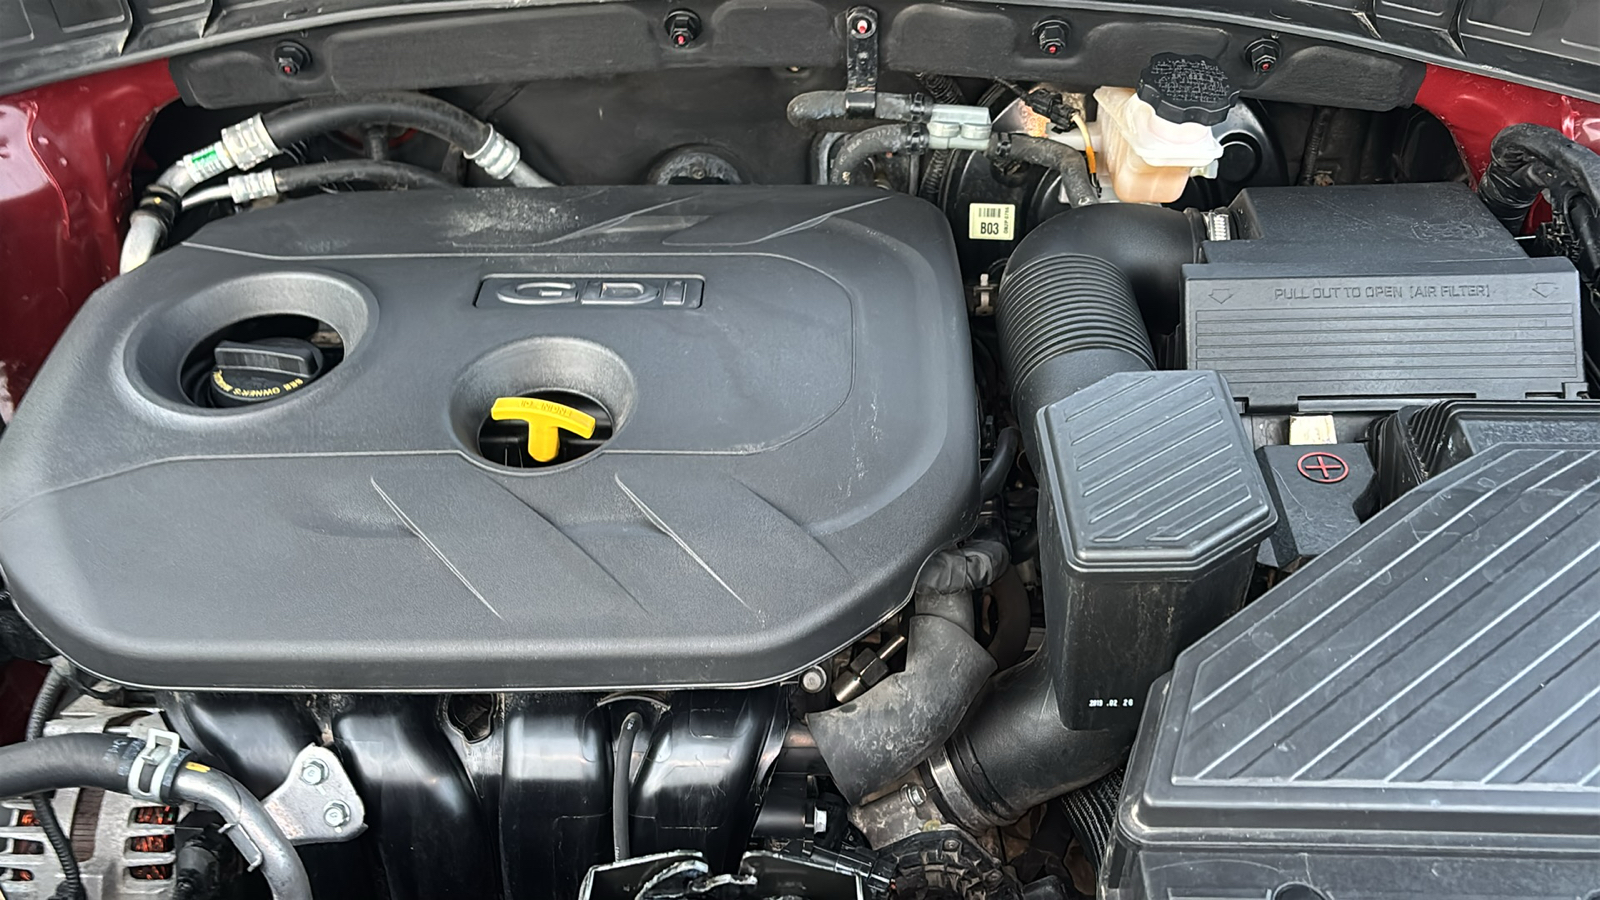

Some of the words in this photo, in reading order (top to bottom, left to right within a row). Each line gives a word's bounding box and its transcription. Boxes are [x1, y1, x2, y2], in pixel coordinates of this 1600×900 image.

[980, 221, 999, 235] B03
[496, 281, 688, 305] GDI
[1274, 287, 1310, 300] PULL
[1312, 286, 1341, 299] OUT
[1343, 286, 1361, 299] TO
[1365, 285, 1403, 299] OPEN
[232, 386, 281, 398] OWNER'S
